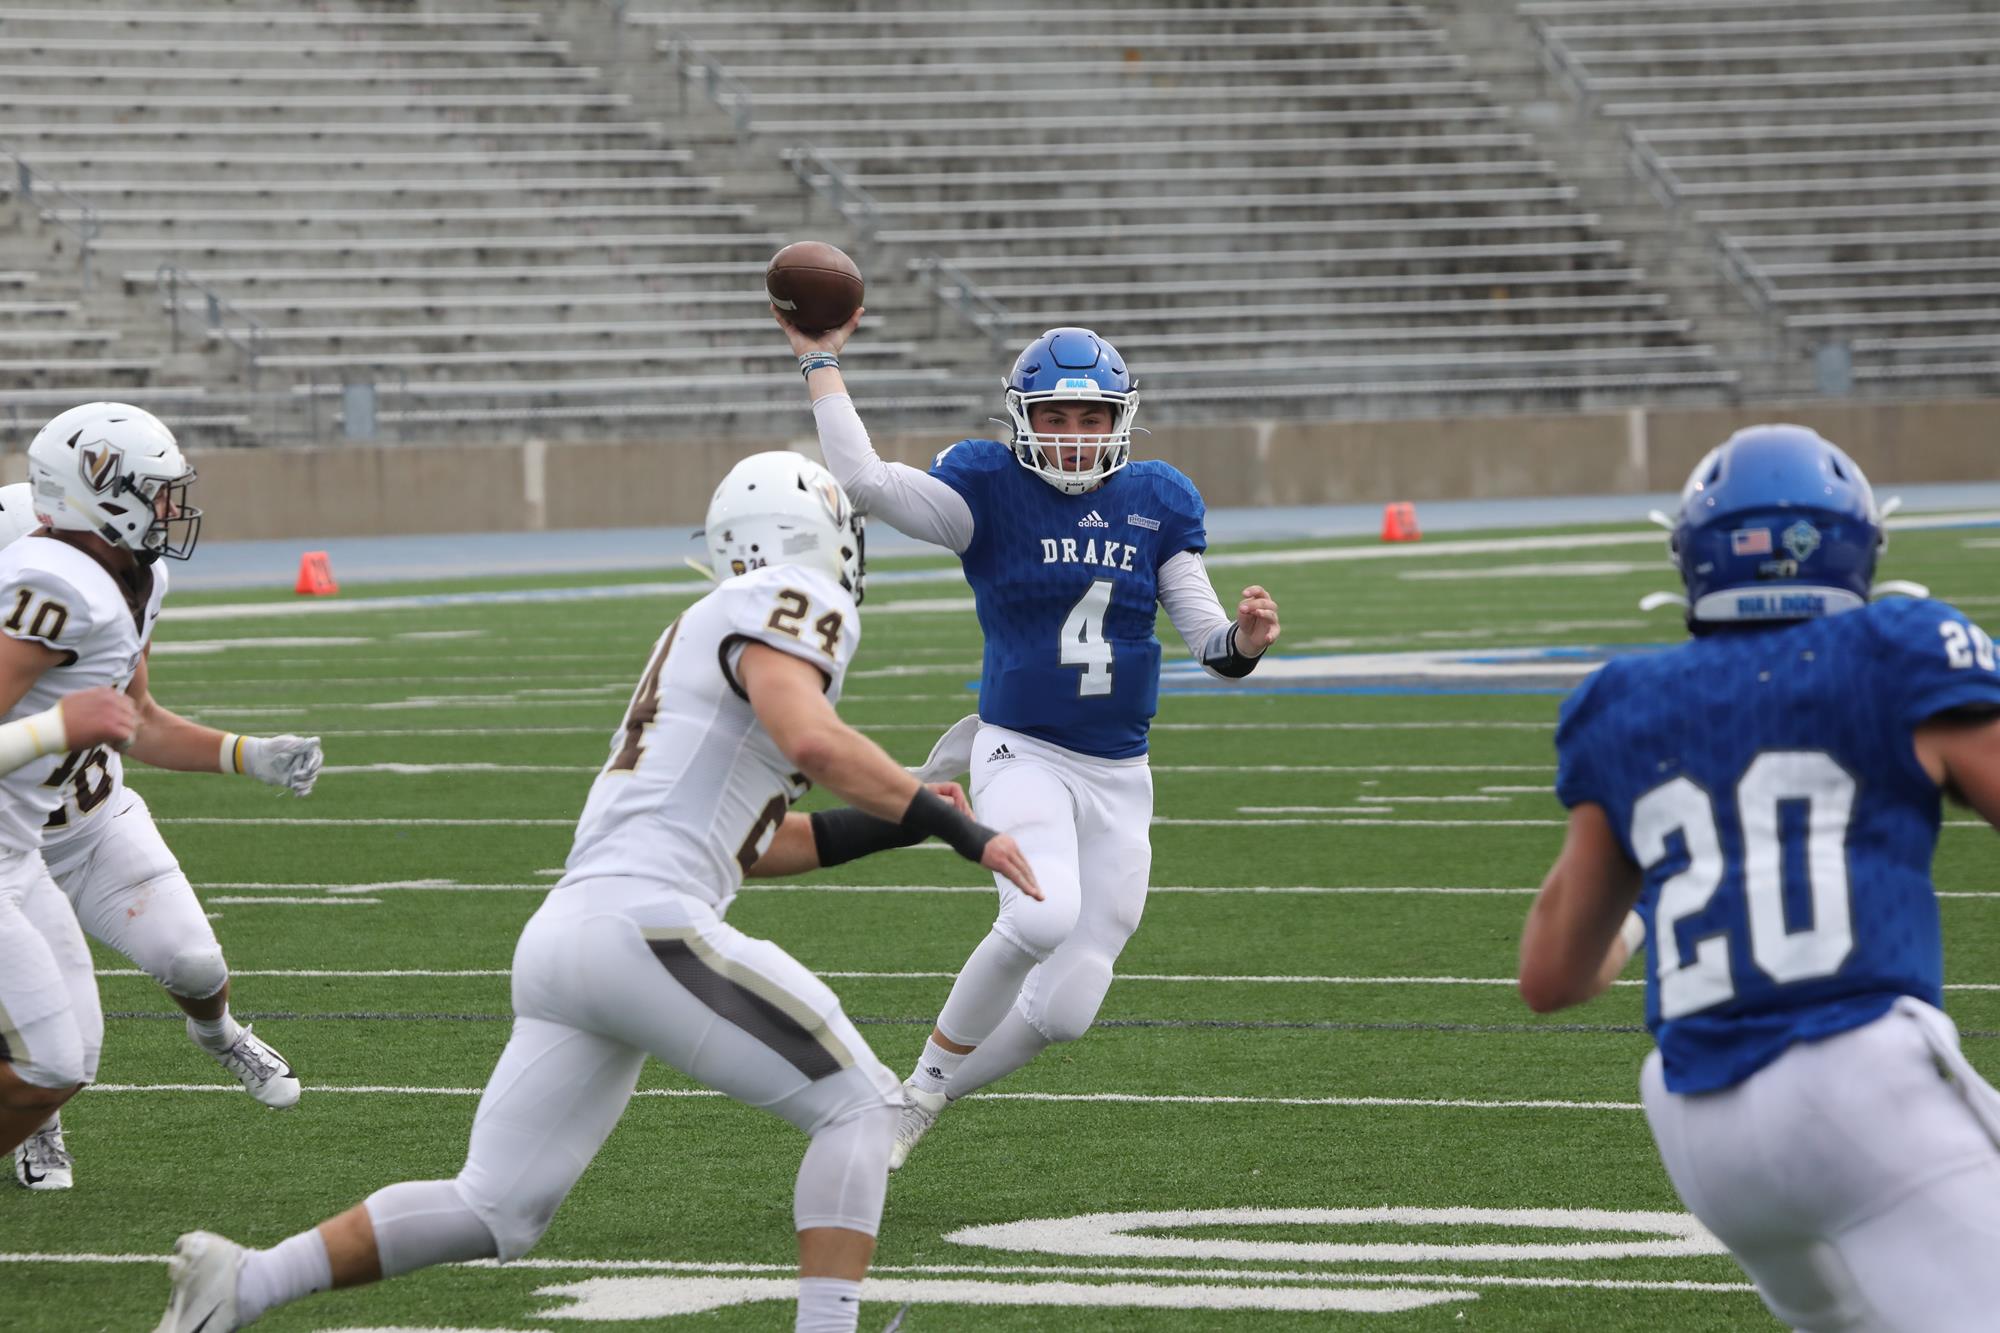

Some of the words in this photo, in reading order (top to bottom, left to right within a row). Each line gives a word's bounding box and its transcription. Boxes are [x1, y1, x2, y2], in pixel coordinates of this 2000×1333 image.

[1078, 519, 1109, 529] adidas
[1041, 537, 1137, 572] DRAKE
[2, 588, 70, 642] 10
[766, 589, 843, 660] 24
[1060, 580, 1113, 697] 4
[1938, 620, 1997, 672] 20
[1630, 751, 1857, 1019] 20
